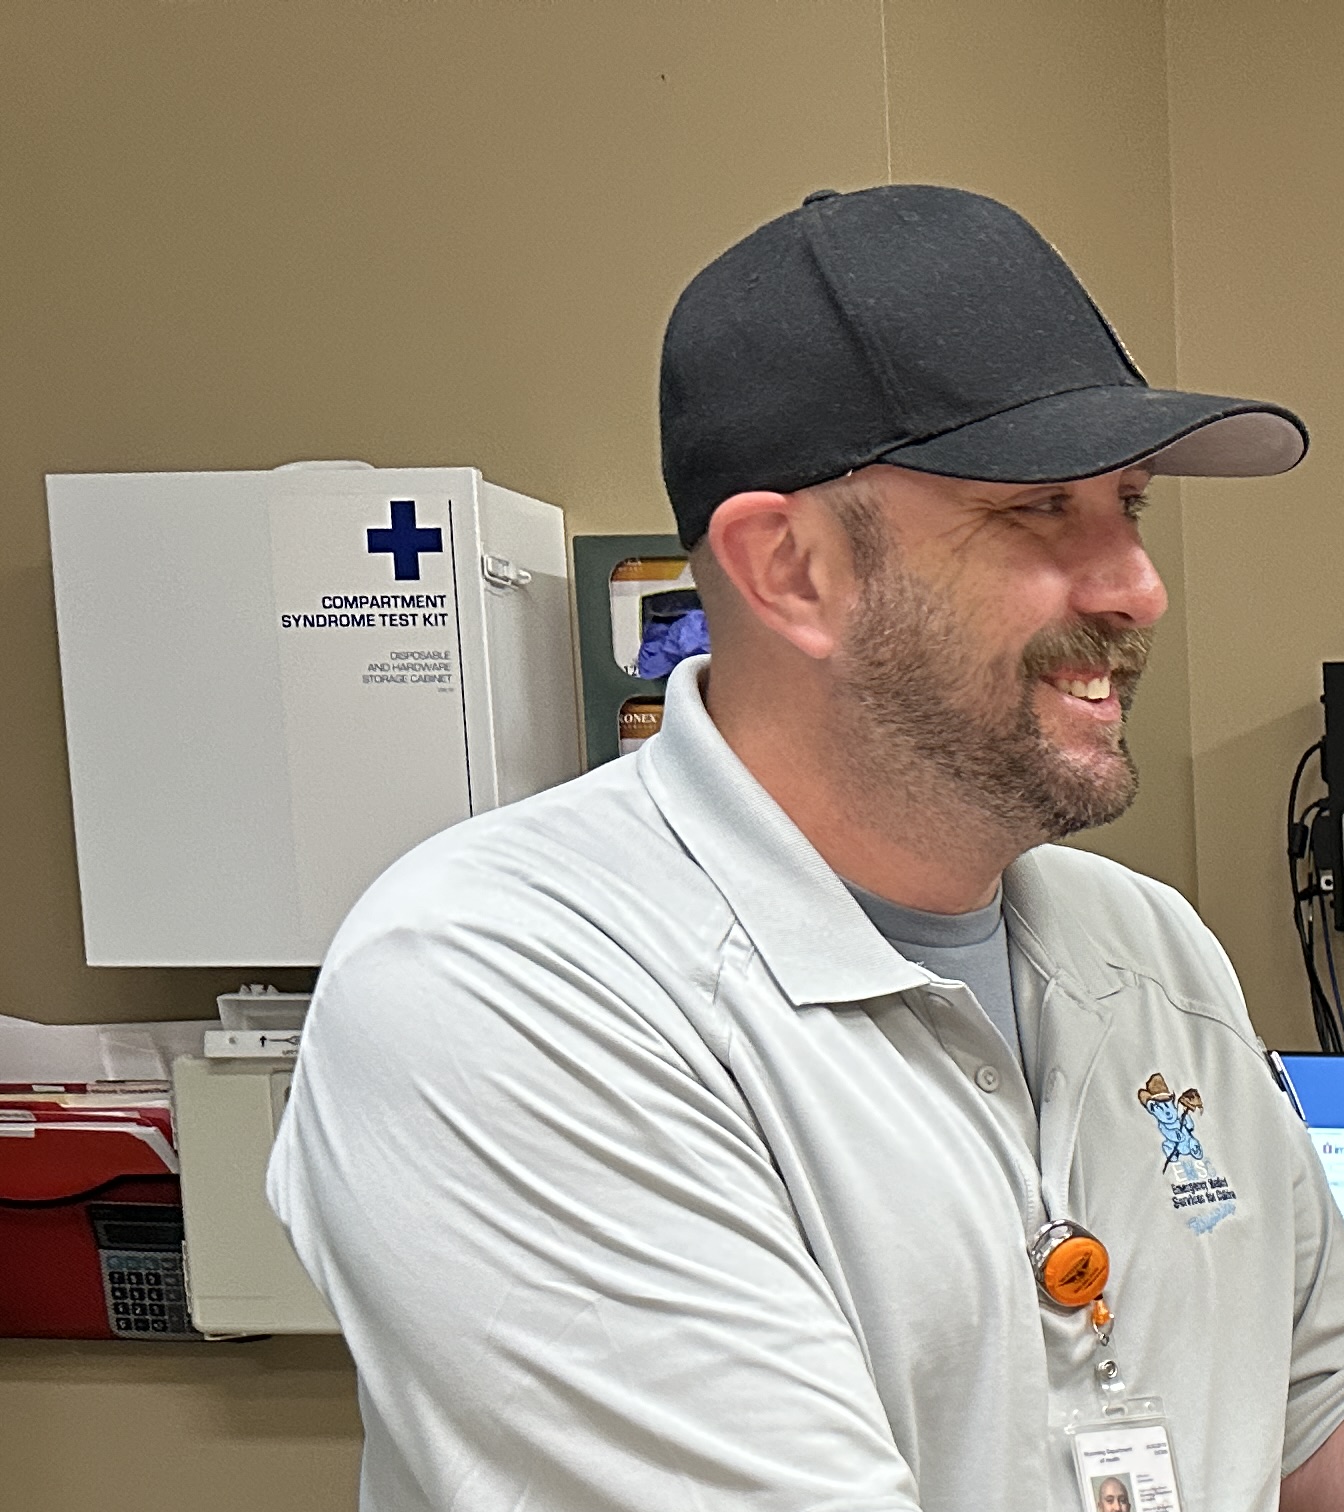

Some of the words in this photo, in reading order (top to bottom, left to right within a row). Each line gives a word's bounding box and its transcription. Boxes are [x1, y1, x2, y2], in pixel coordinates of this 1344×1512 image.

[321, 594, 447, 610] COMPARTMENT
[281, 613, 376, 629] SYNDROME
[378, 613, 419, 627] TEST
[422, 612, 449, 627] KIT
[367, 663, 391, 672] AND
[362, 674, 409, 684] STORAGE
